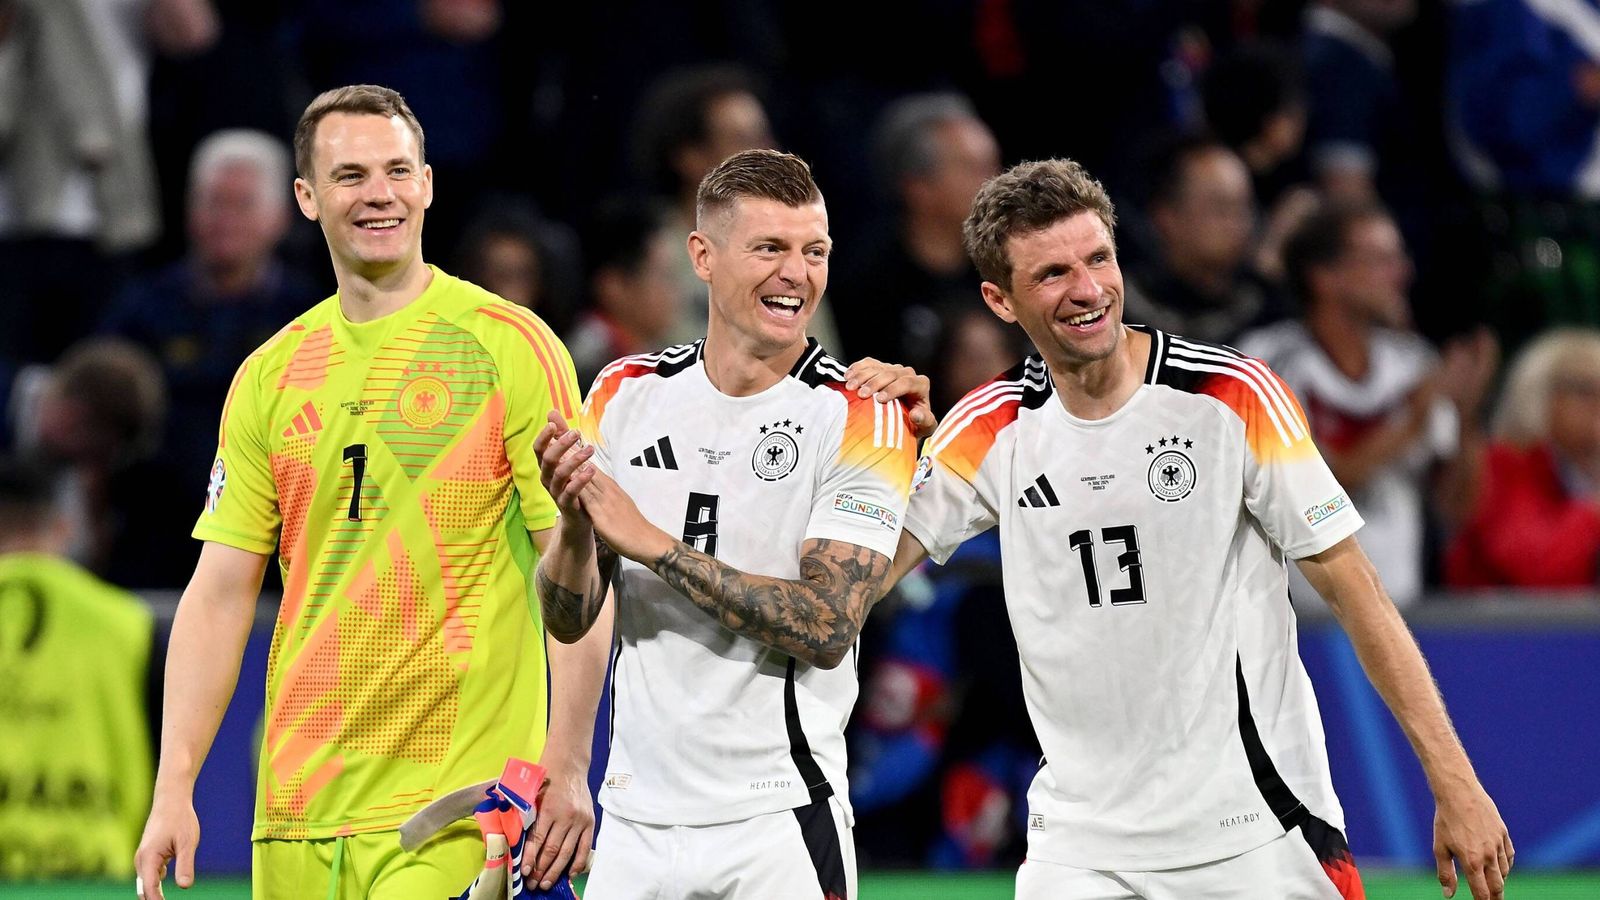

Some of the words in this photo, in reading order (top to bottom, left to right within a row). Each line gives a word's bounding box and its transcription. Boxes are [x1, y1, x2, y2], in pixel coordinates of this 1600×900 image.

[1156, 456, 1184, 468] DEUTSCHER
[343, 443, 368, 522] 1
[836, 492, 853, 500] UEFA
[834, 499, 898, 525] FOUNDATION
[1303, 505, 1319, 516] UEFA
[1306, 495, 1346, 524] FOUNDA
[1068, 524, 1148, 608] 13
